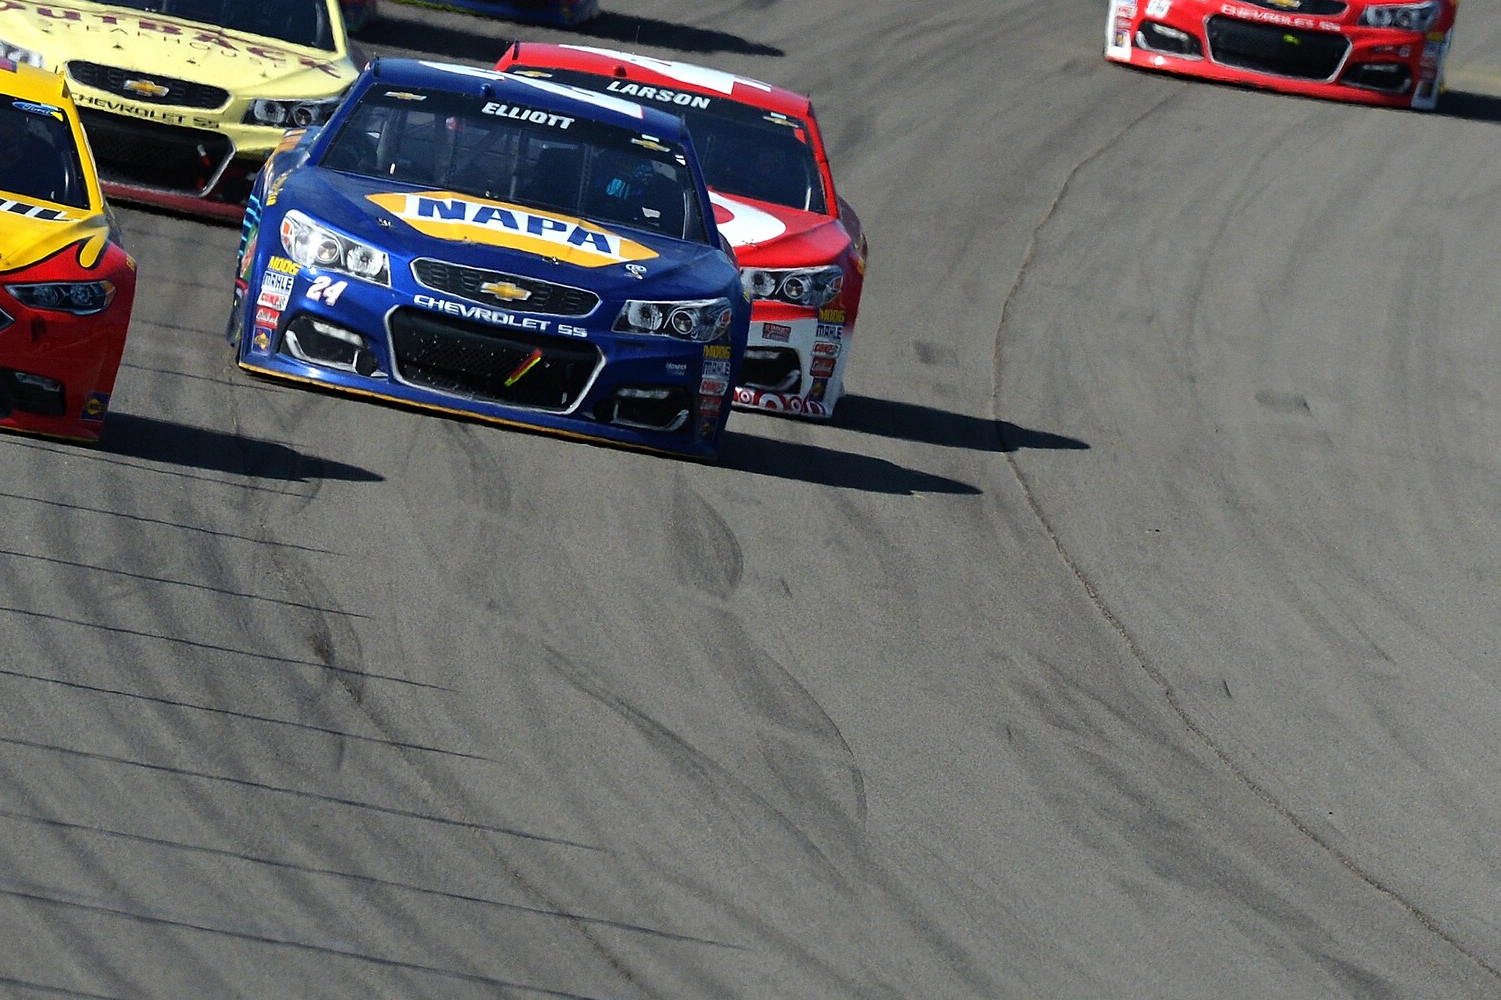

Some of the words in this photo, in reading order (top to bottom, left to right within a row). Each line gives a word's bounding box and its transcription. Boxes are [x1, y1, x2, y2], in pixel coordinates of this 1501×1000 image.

[606, 80, 711, 110] LARSON
[71, 92, 186, 126] CHEVROLET
[193, 115, 220, 129] SS
[481, 101, 575, 131] ELLIOTT
[416, 196, 612, 255] NAPA
[268, 255, 301, 276] MOOG
[263, 271, 294, 291] MAHLE
[306, 275, 349, 308] 24
[413, 294, 551, 334] CHEVROLET
[558, 324, 588, 338] SS
[820, 308, 846, 323] MOOG
